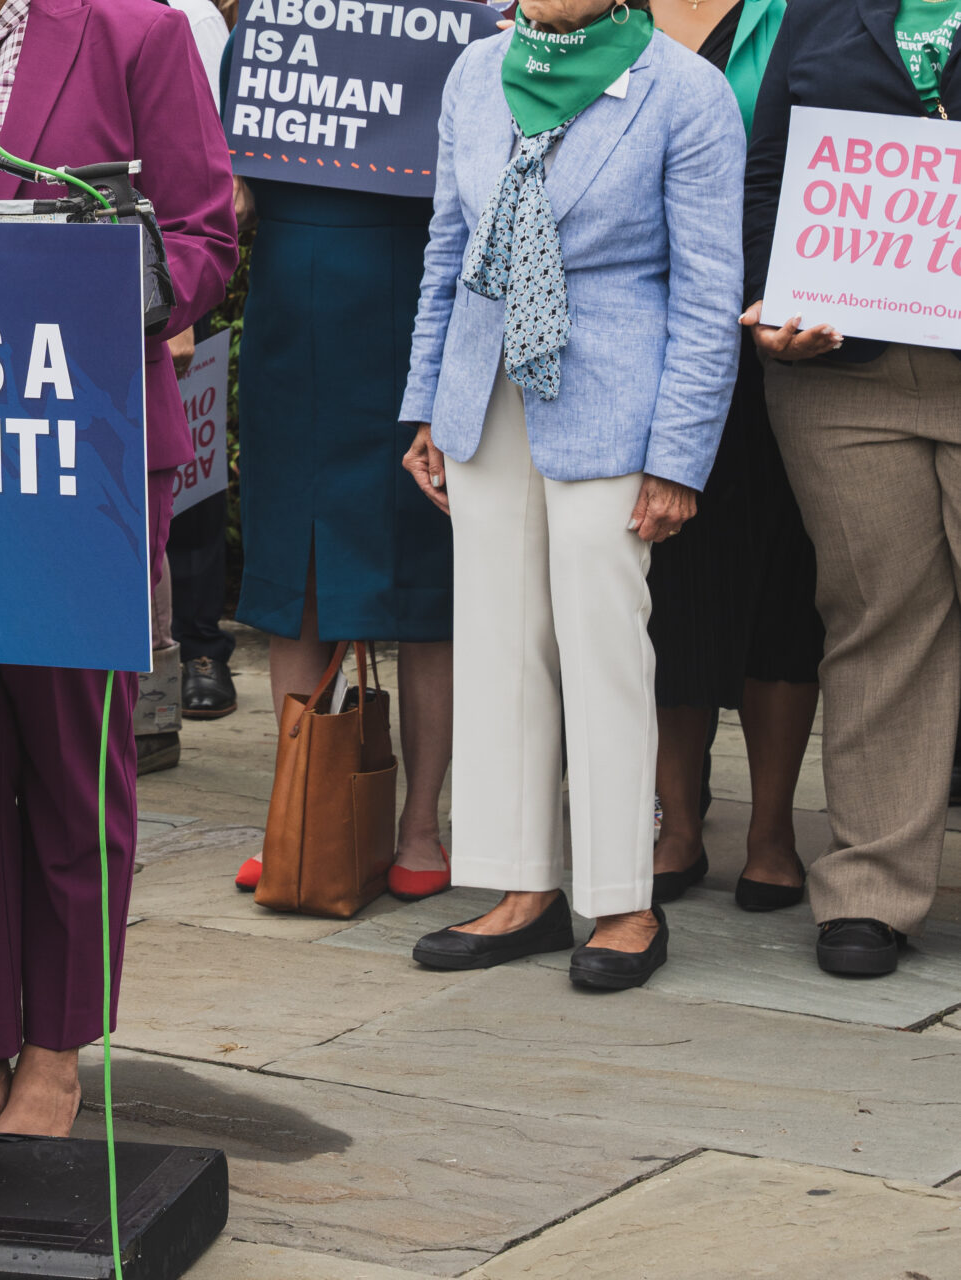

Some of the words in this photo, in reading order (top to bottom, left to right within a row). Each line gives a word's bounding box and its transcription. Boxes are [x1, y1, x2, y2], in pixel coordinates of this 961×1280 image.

[243, 29, 284, 62] IS
[287, 34, 318, 67] A
[548, 32, 586, 45] RIGHT
[525, 55, 550, 74] Ipas
[238, 66, 403, 115] HUMAN
[232, 104, 367, 149] RIGHT
[803, 180, 872, 219] ON
[885, 188, 961, 230] ou
[796, 224, 913, 269] own
[24, 322, 75, 400] A
